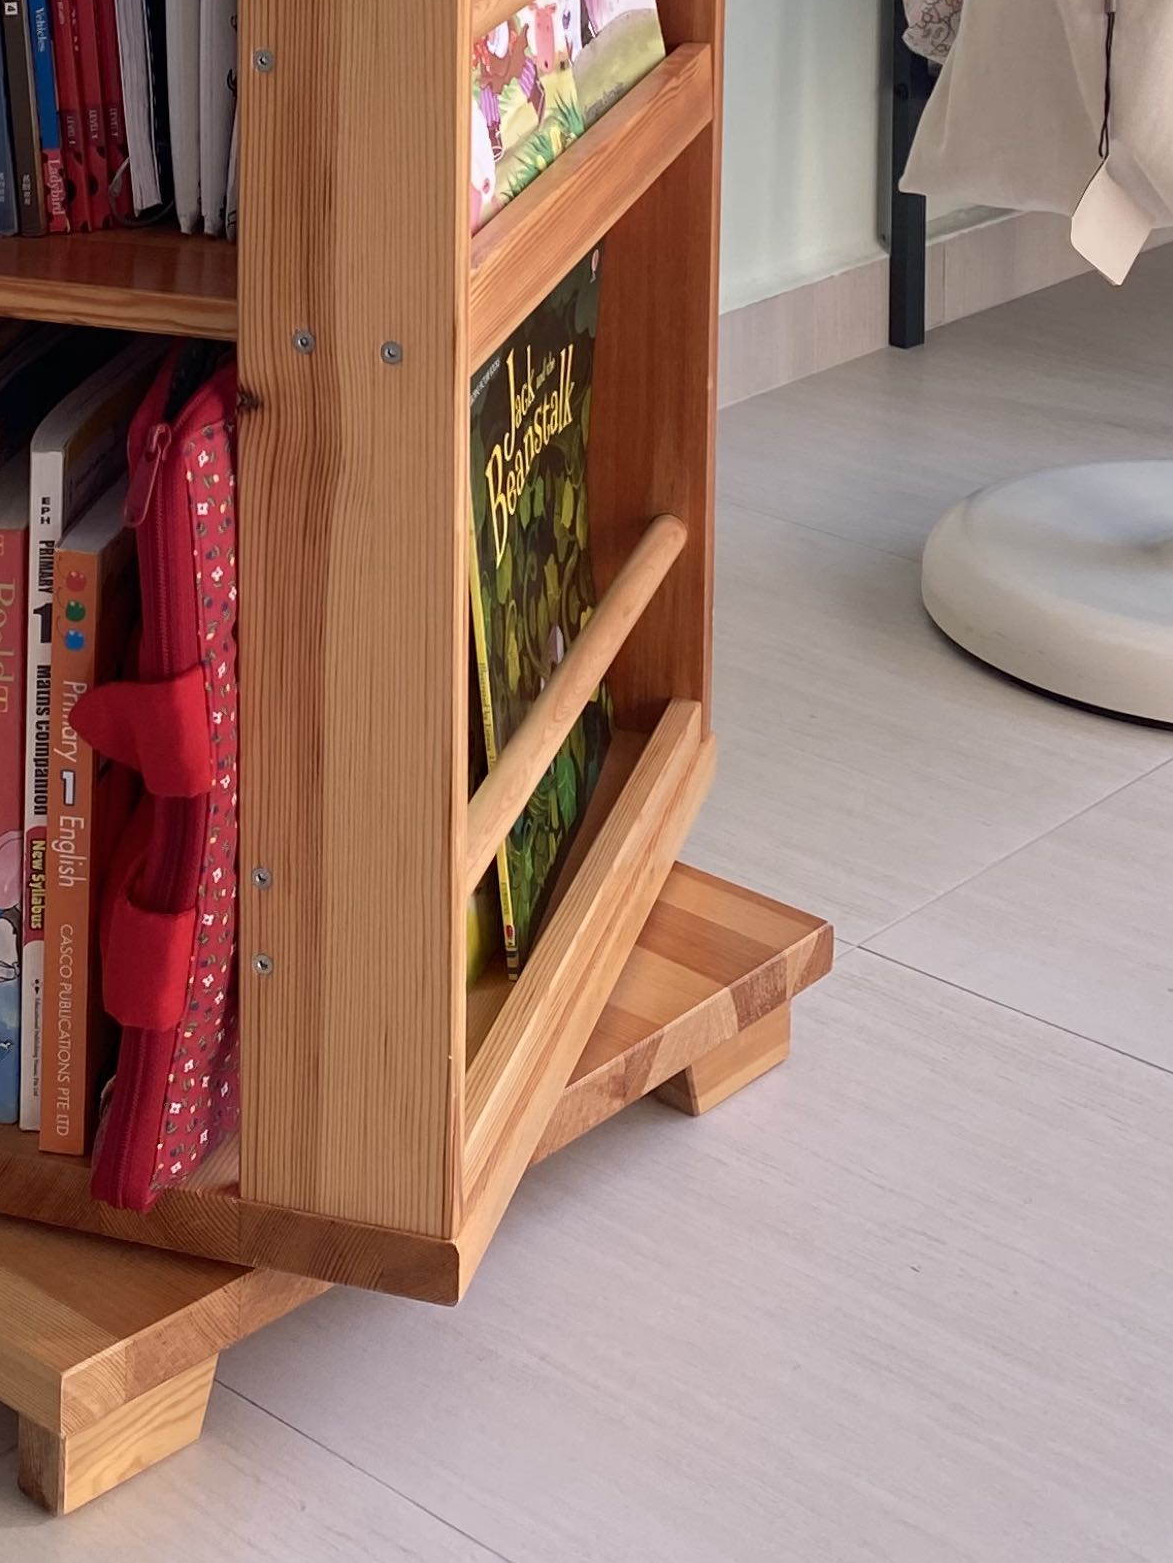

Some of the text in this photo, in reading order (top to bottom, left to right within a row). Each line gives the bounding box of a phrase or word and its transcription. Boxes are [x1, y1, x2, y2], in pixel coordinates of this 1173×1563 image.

[47, 159, 65, 216] Ladybird
[504, 344, 535, 462] Jack
[485, 343, 575, 571] Beanstalk
[33, 540, 54, 643] PRIMARY 1
[29, 840, 46, 929] New Syllabus
[51, 816, 87, 887] English
[56, 924, 73, 1136] CASCO PUBLICATIONS PTE LTD
